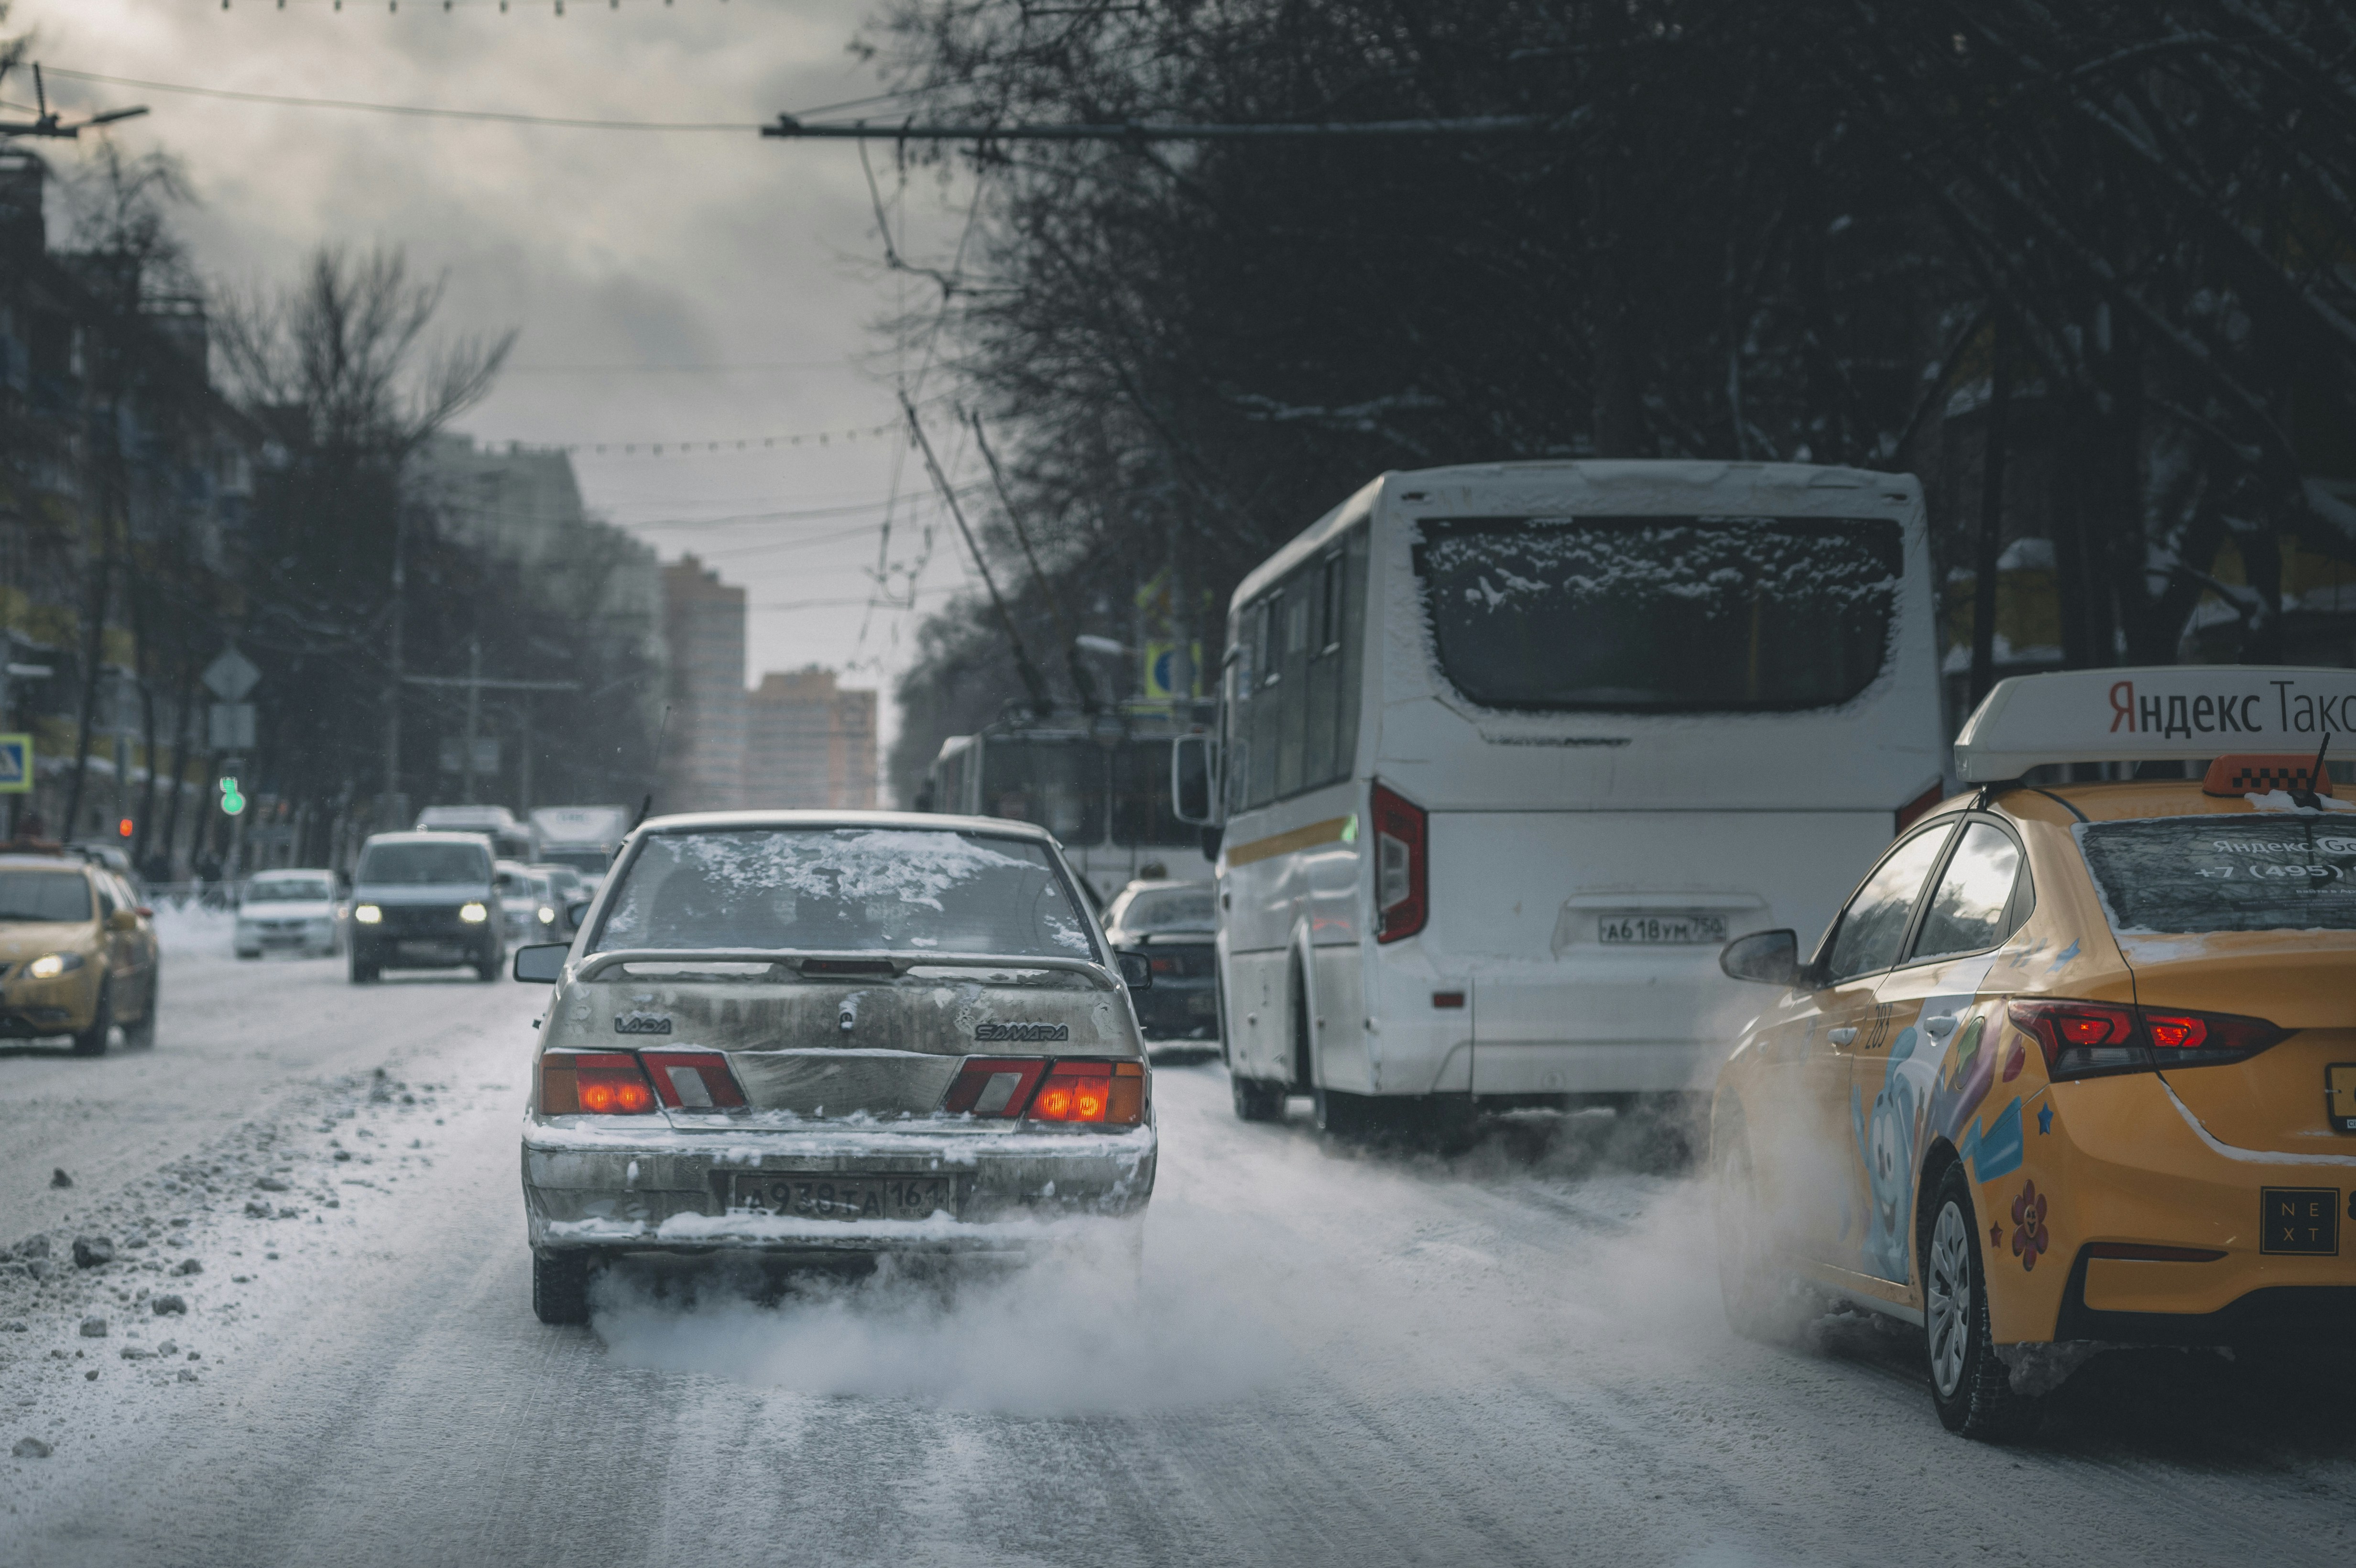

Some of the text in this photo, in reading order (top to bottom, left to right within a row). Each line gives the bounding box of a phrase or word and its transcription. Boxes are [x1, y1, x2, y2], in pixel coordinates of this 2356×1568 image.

[2109, 681, 2262, 739] Яндекс
[2213, 840, 2313, 853] Яндекс
[2194, 866, 2234, 878] +7
[2249, 865, 2344, 879] (495)
[615, 1017, 671, 1035] LADA
[974, 1024, 1069, 1041] SAMARA
[1865, 1003, 1893, 1049] 283
